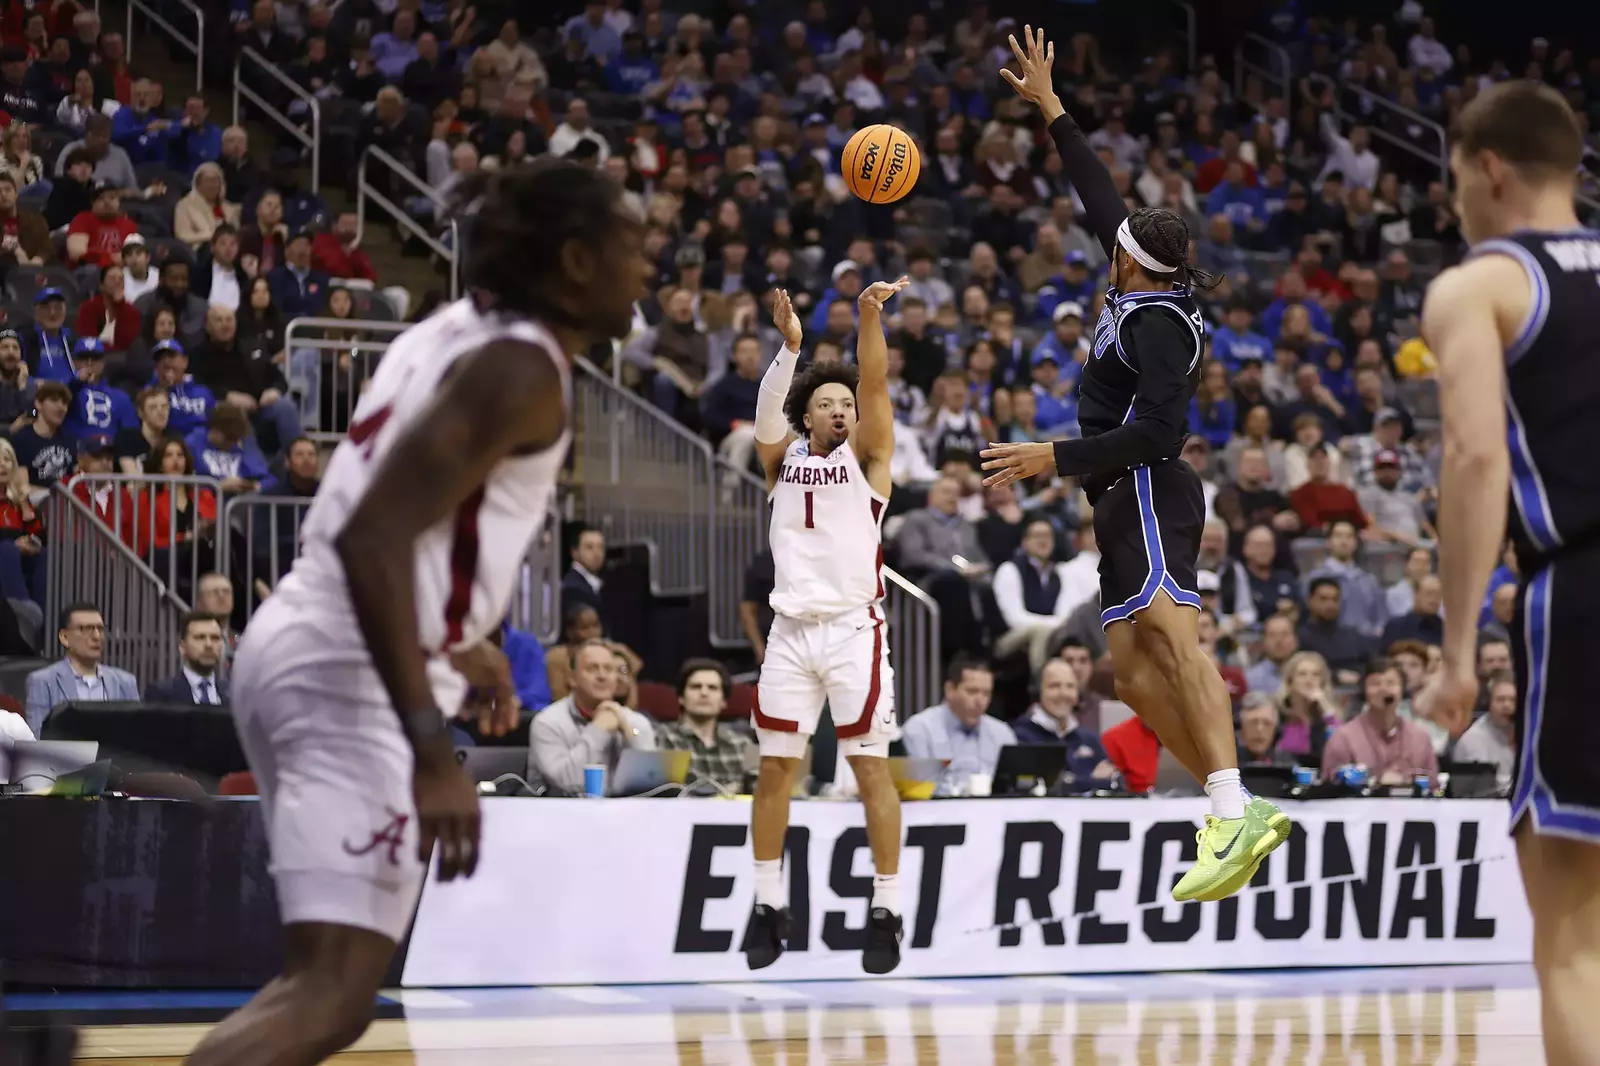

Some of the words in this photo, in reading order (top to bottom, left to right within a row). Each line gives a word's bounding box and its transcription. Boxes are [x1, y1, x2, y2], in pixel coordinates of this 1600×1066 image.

[880, 143, 906, 193] Wilson
[779, 464, 849, 486] ALABAMA
[804, 491, 815, 529] 1
